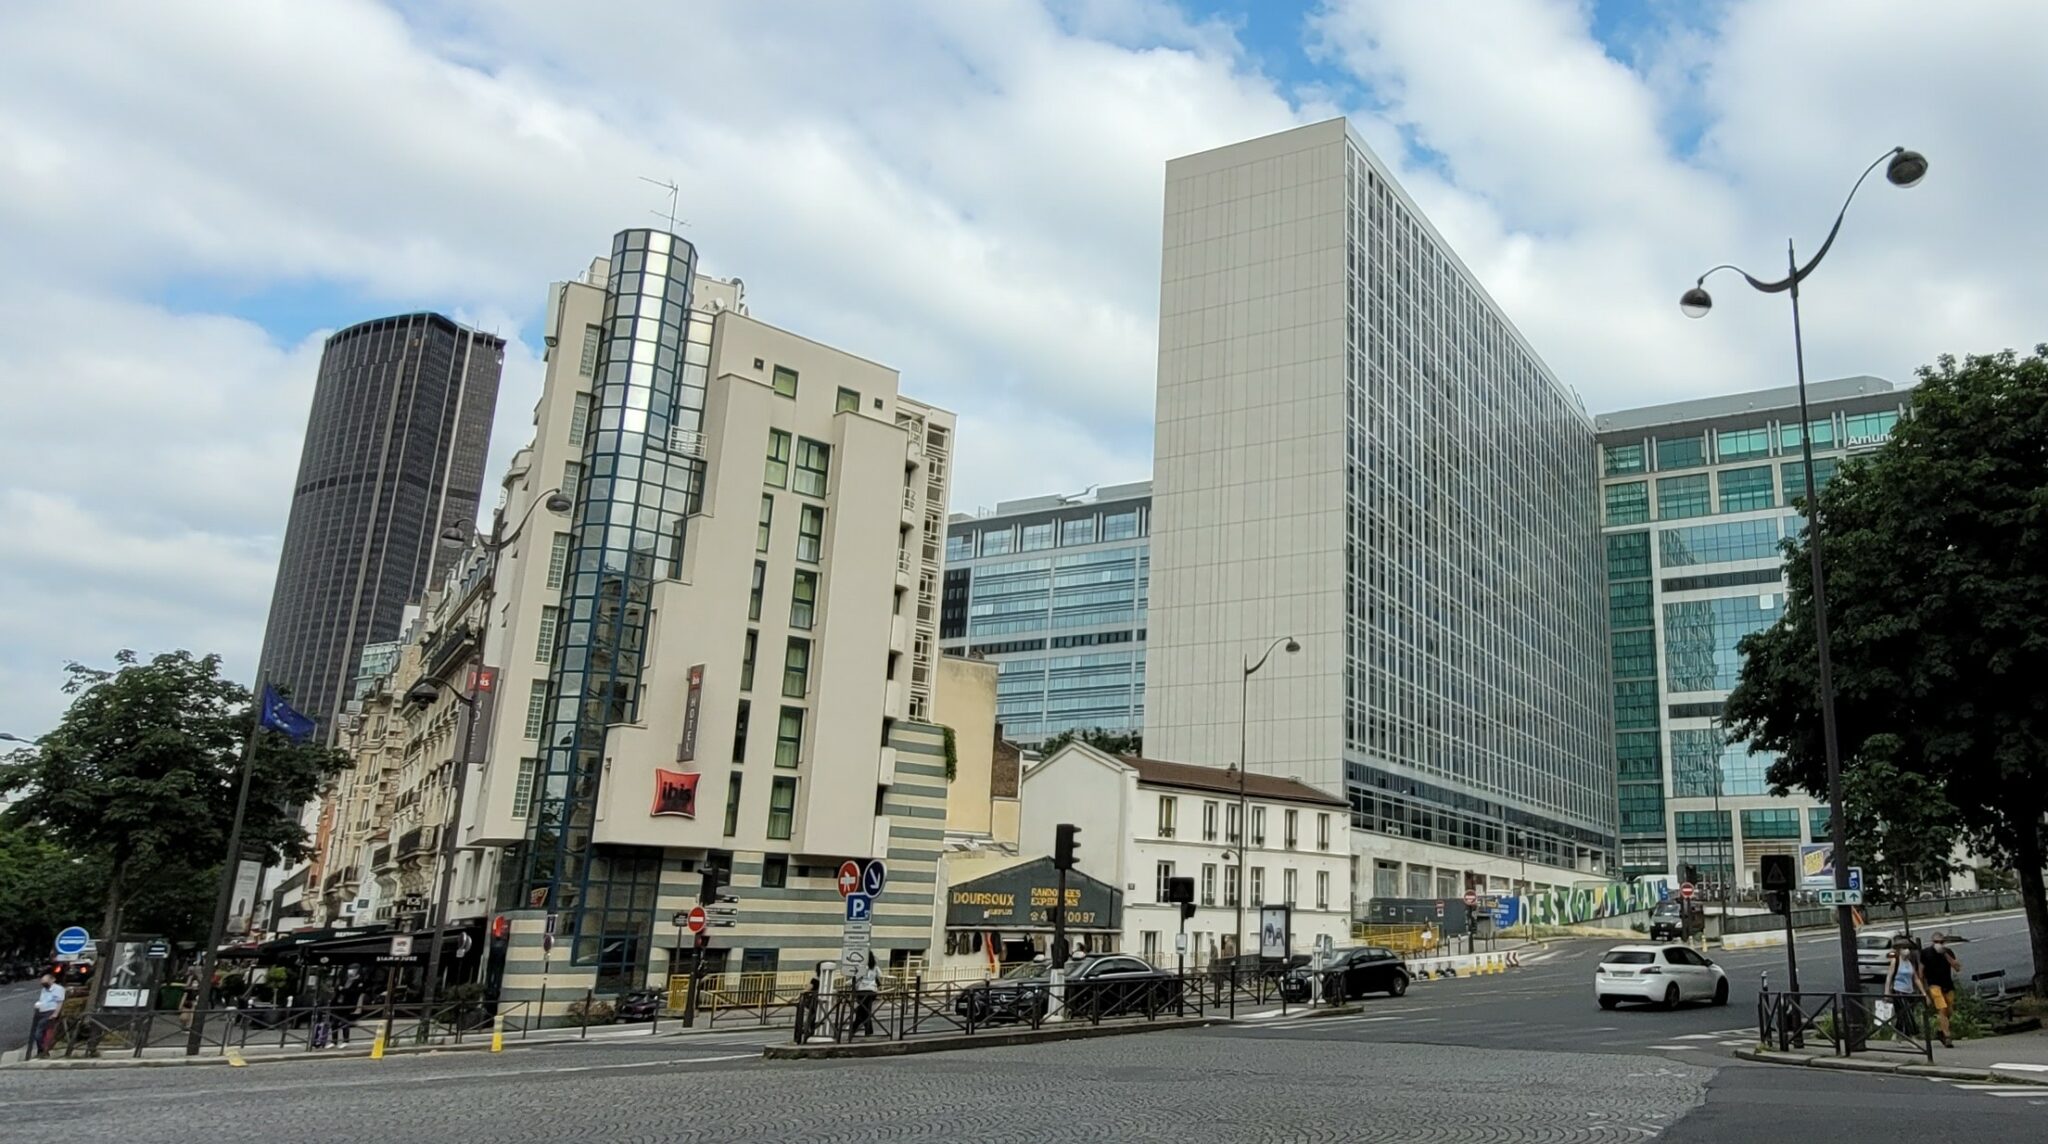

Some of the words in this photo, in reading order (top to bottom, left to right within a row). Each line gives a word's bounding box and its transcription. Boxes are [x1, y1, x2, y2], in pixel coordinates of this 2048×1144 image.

[684, 697, 697, 753] HOTEL
[662, 781, 692, 803] ibis
[953, 892, 1015, 906] DOURSOUX
[1031, 887, 1081, 898] RANDOEES
[852, 898, 865, 917] P
[1084, 912, 1095, 923] 97
